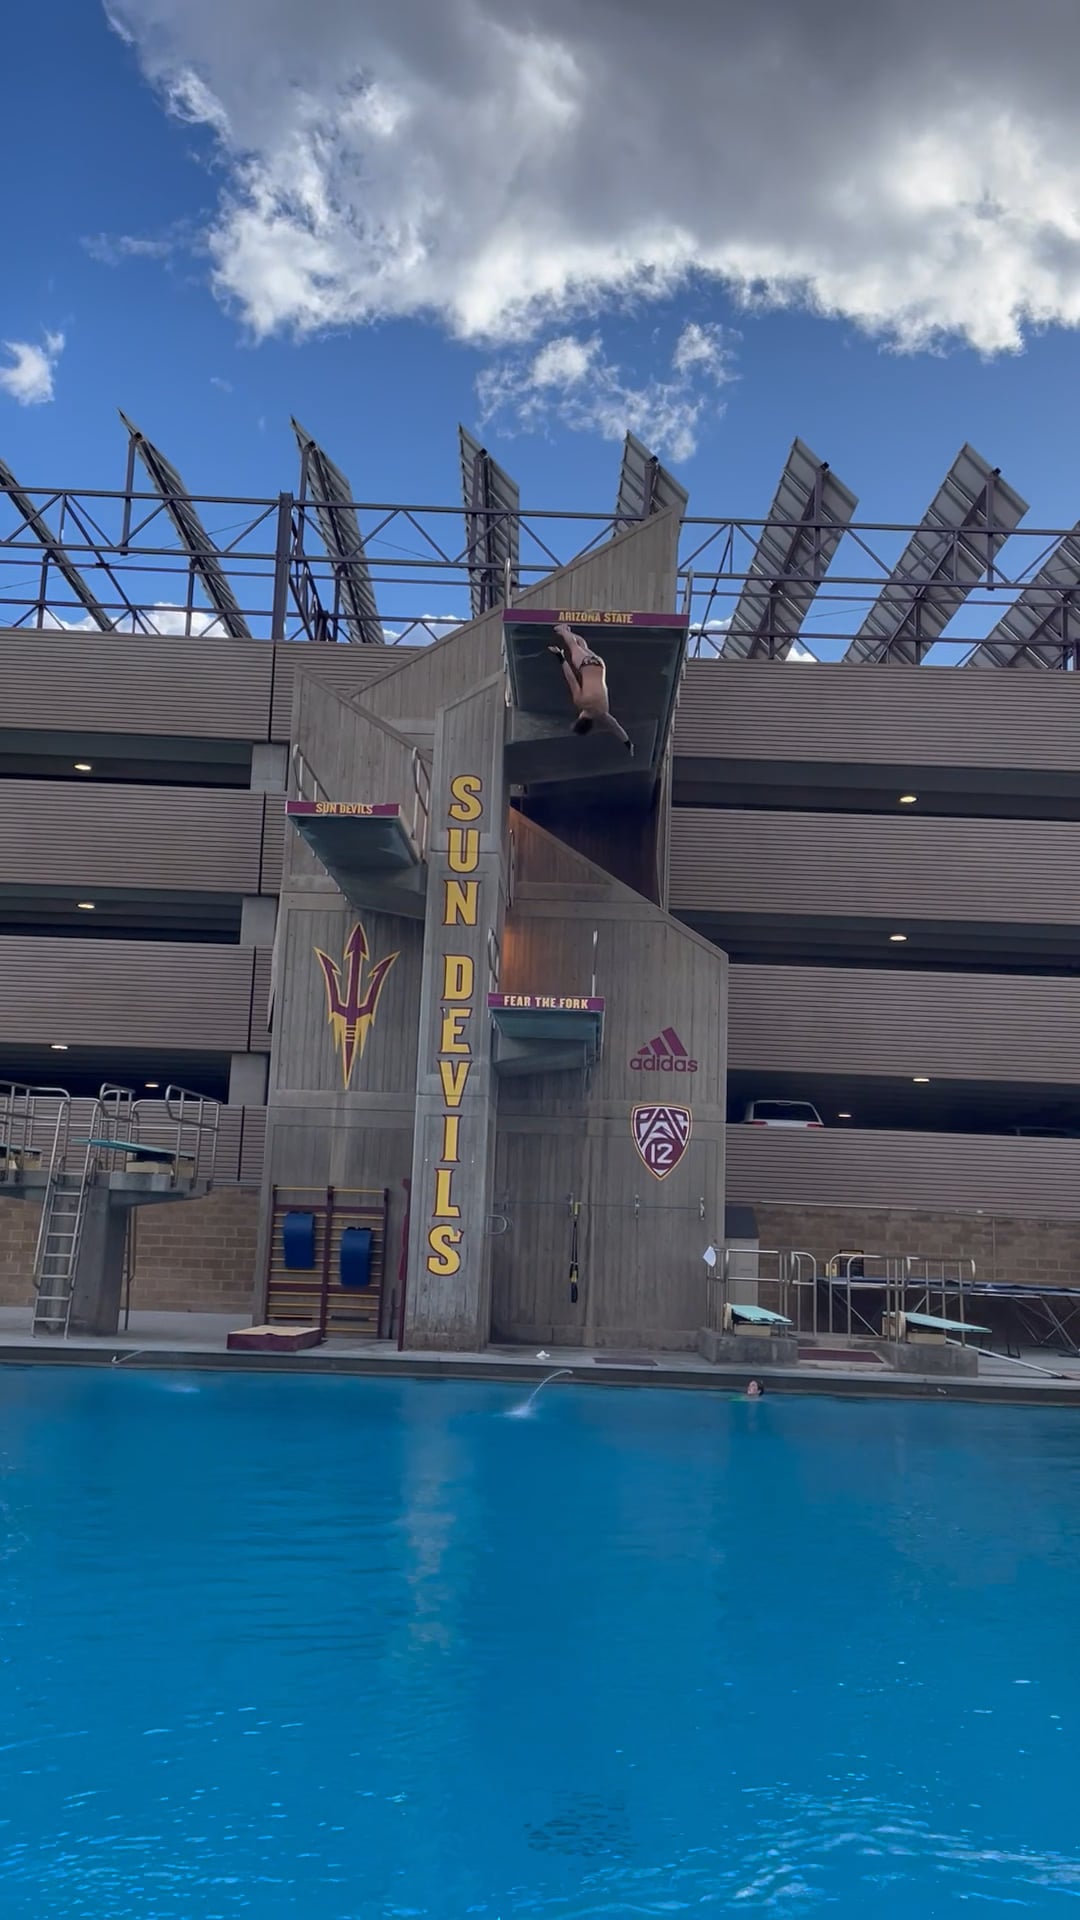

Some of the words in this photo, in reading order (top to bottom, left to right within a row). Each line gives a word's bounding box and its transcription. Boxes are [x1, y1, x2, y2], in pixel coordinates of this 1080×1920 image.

[559, 611, 600, 622] ARIZONA
[603, 613, 633, 624] STATE
[315, 803, 337, 813] SUN
[340, 804, 373, 814] DEVILS
[442, 774, 484, 926] SUN
[504, 995, 531, 1007] FEAR
[535, 997, 556, 1008] THE
[559, 998, 589, 1009] FORK
[630, 1055, 698, 1072] adidas
[426, 954, 475, 1277] DEVILS
[637, 1108, 689, 1148] PAC
[650, 1143, 673, 1164] 12
